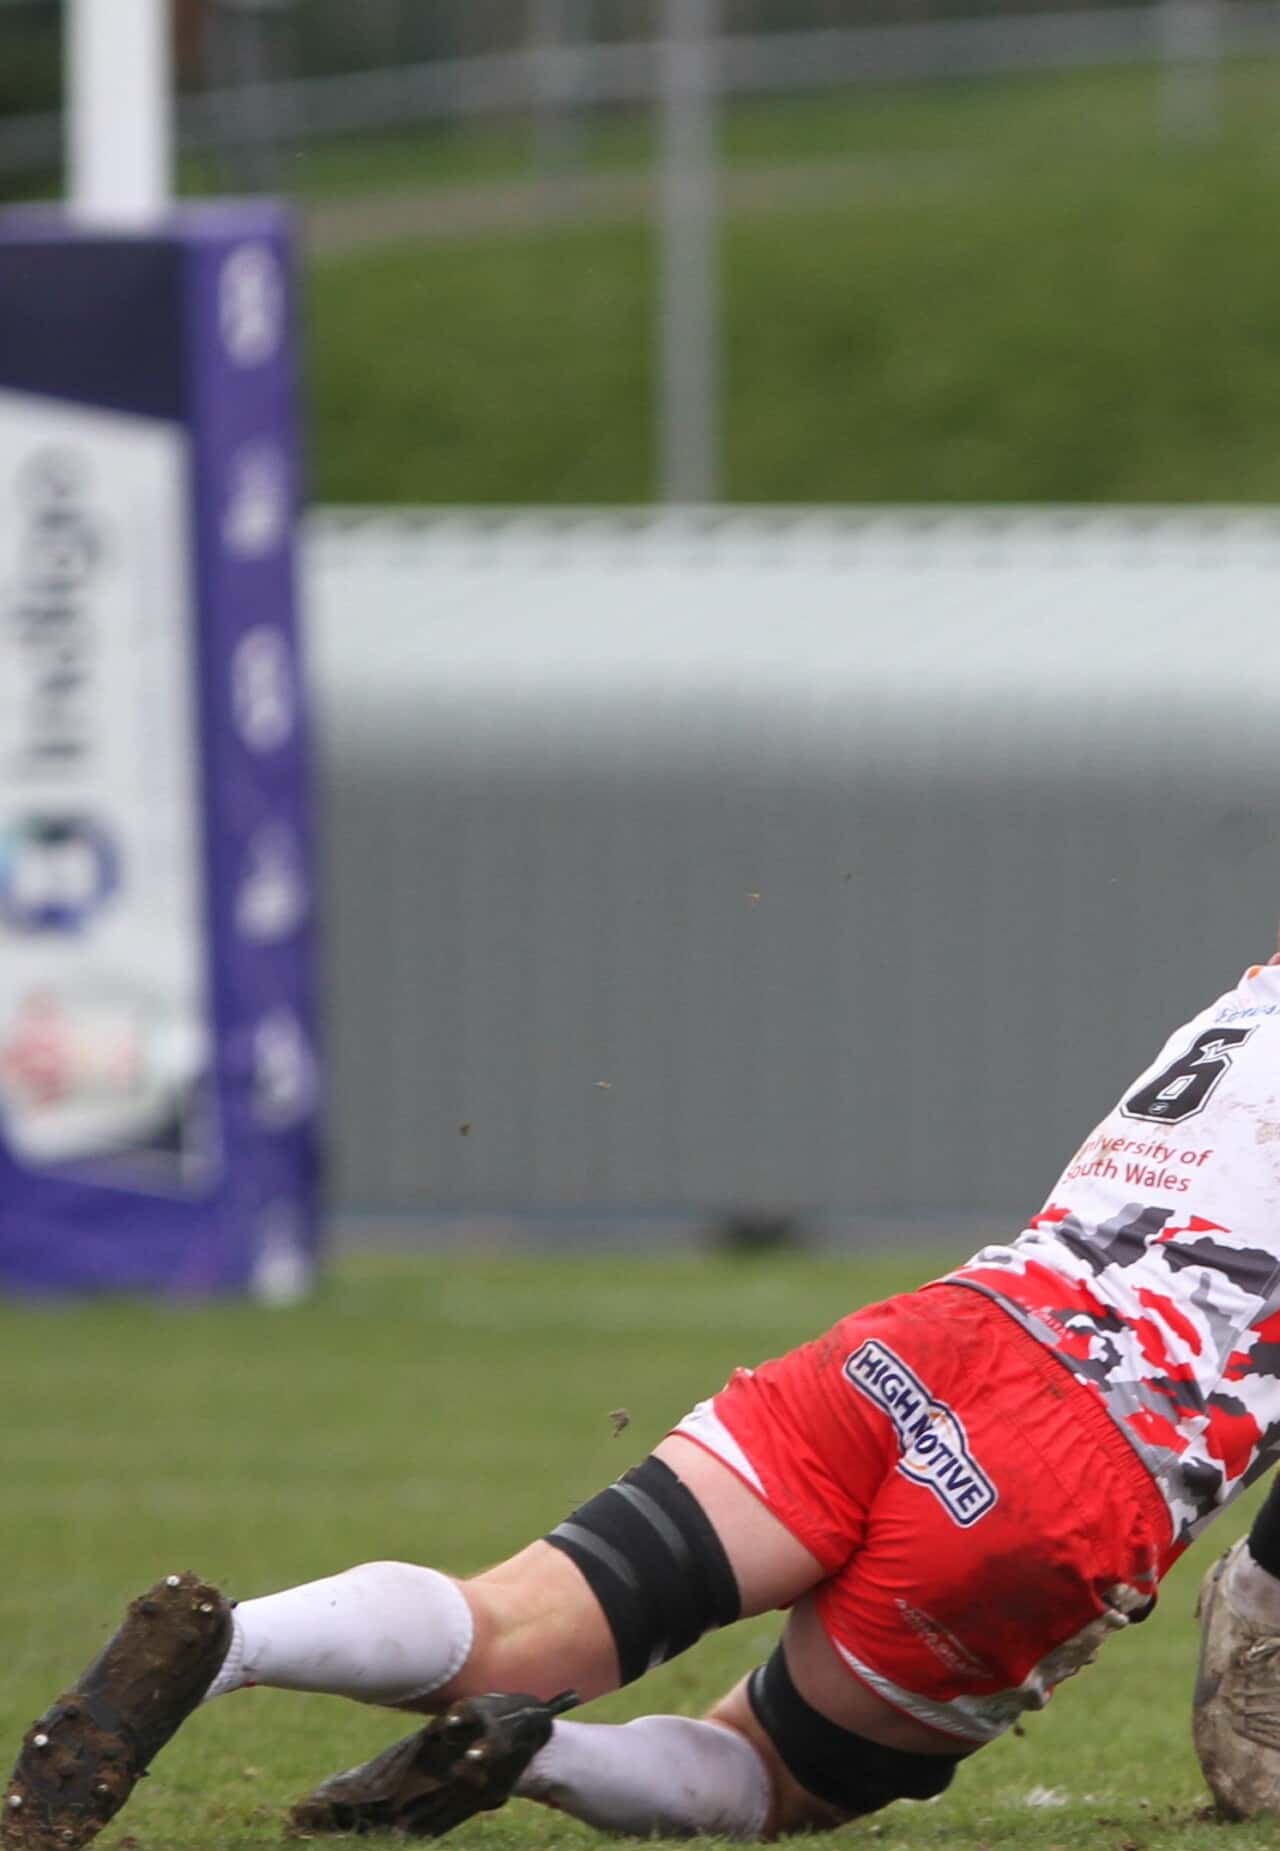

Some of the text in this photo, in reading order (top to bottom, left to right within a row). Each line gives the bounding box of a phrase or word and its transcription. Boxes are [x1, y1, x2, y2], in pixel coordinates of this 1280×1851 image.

[1119, 1024, 1260, 1126] 6
[1066, 1157, 1193, 1193] outh Wales
[1180, 1149, 1214, 1167] of
[855, 1348, 922, 1422] HIGH
